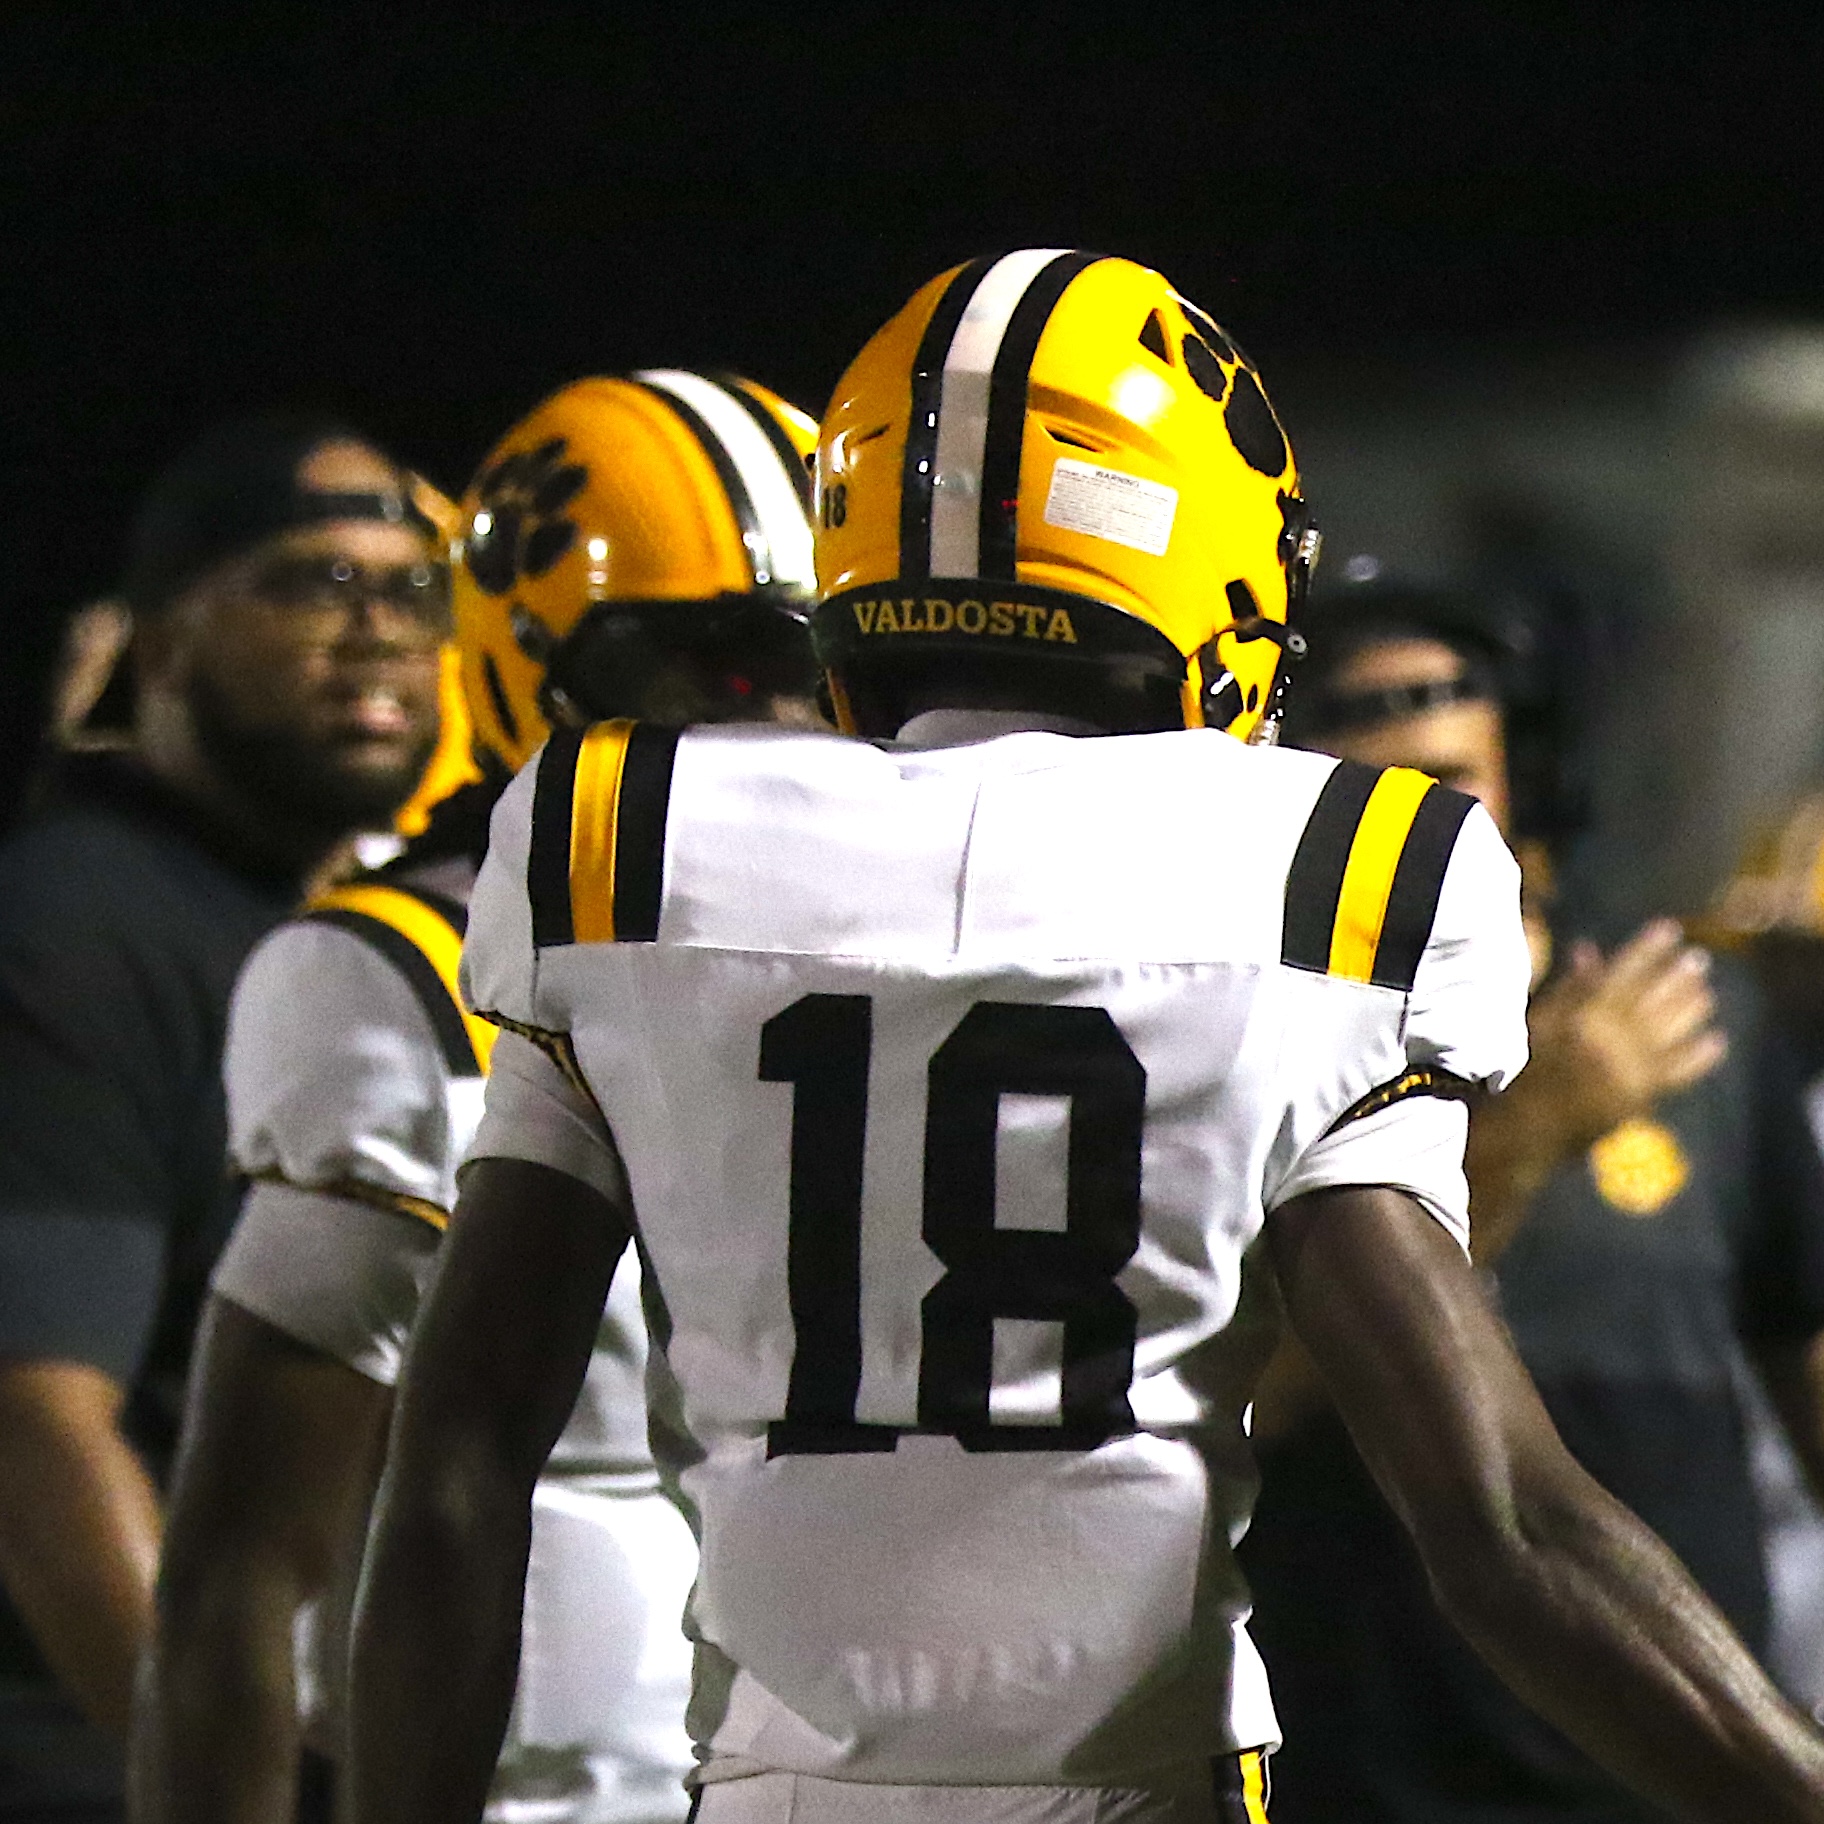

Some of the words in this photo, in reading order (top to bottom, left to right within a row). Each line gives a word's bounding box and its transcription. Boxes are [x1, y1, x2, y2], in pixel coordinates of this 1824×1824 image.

[824, 484, 846, 529] 18
[853, 600, 1078, 644] VALDOSTA
[758, 993, 1146, 1460] 18
